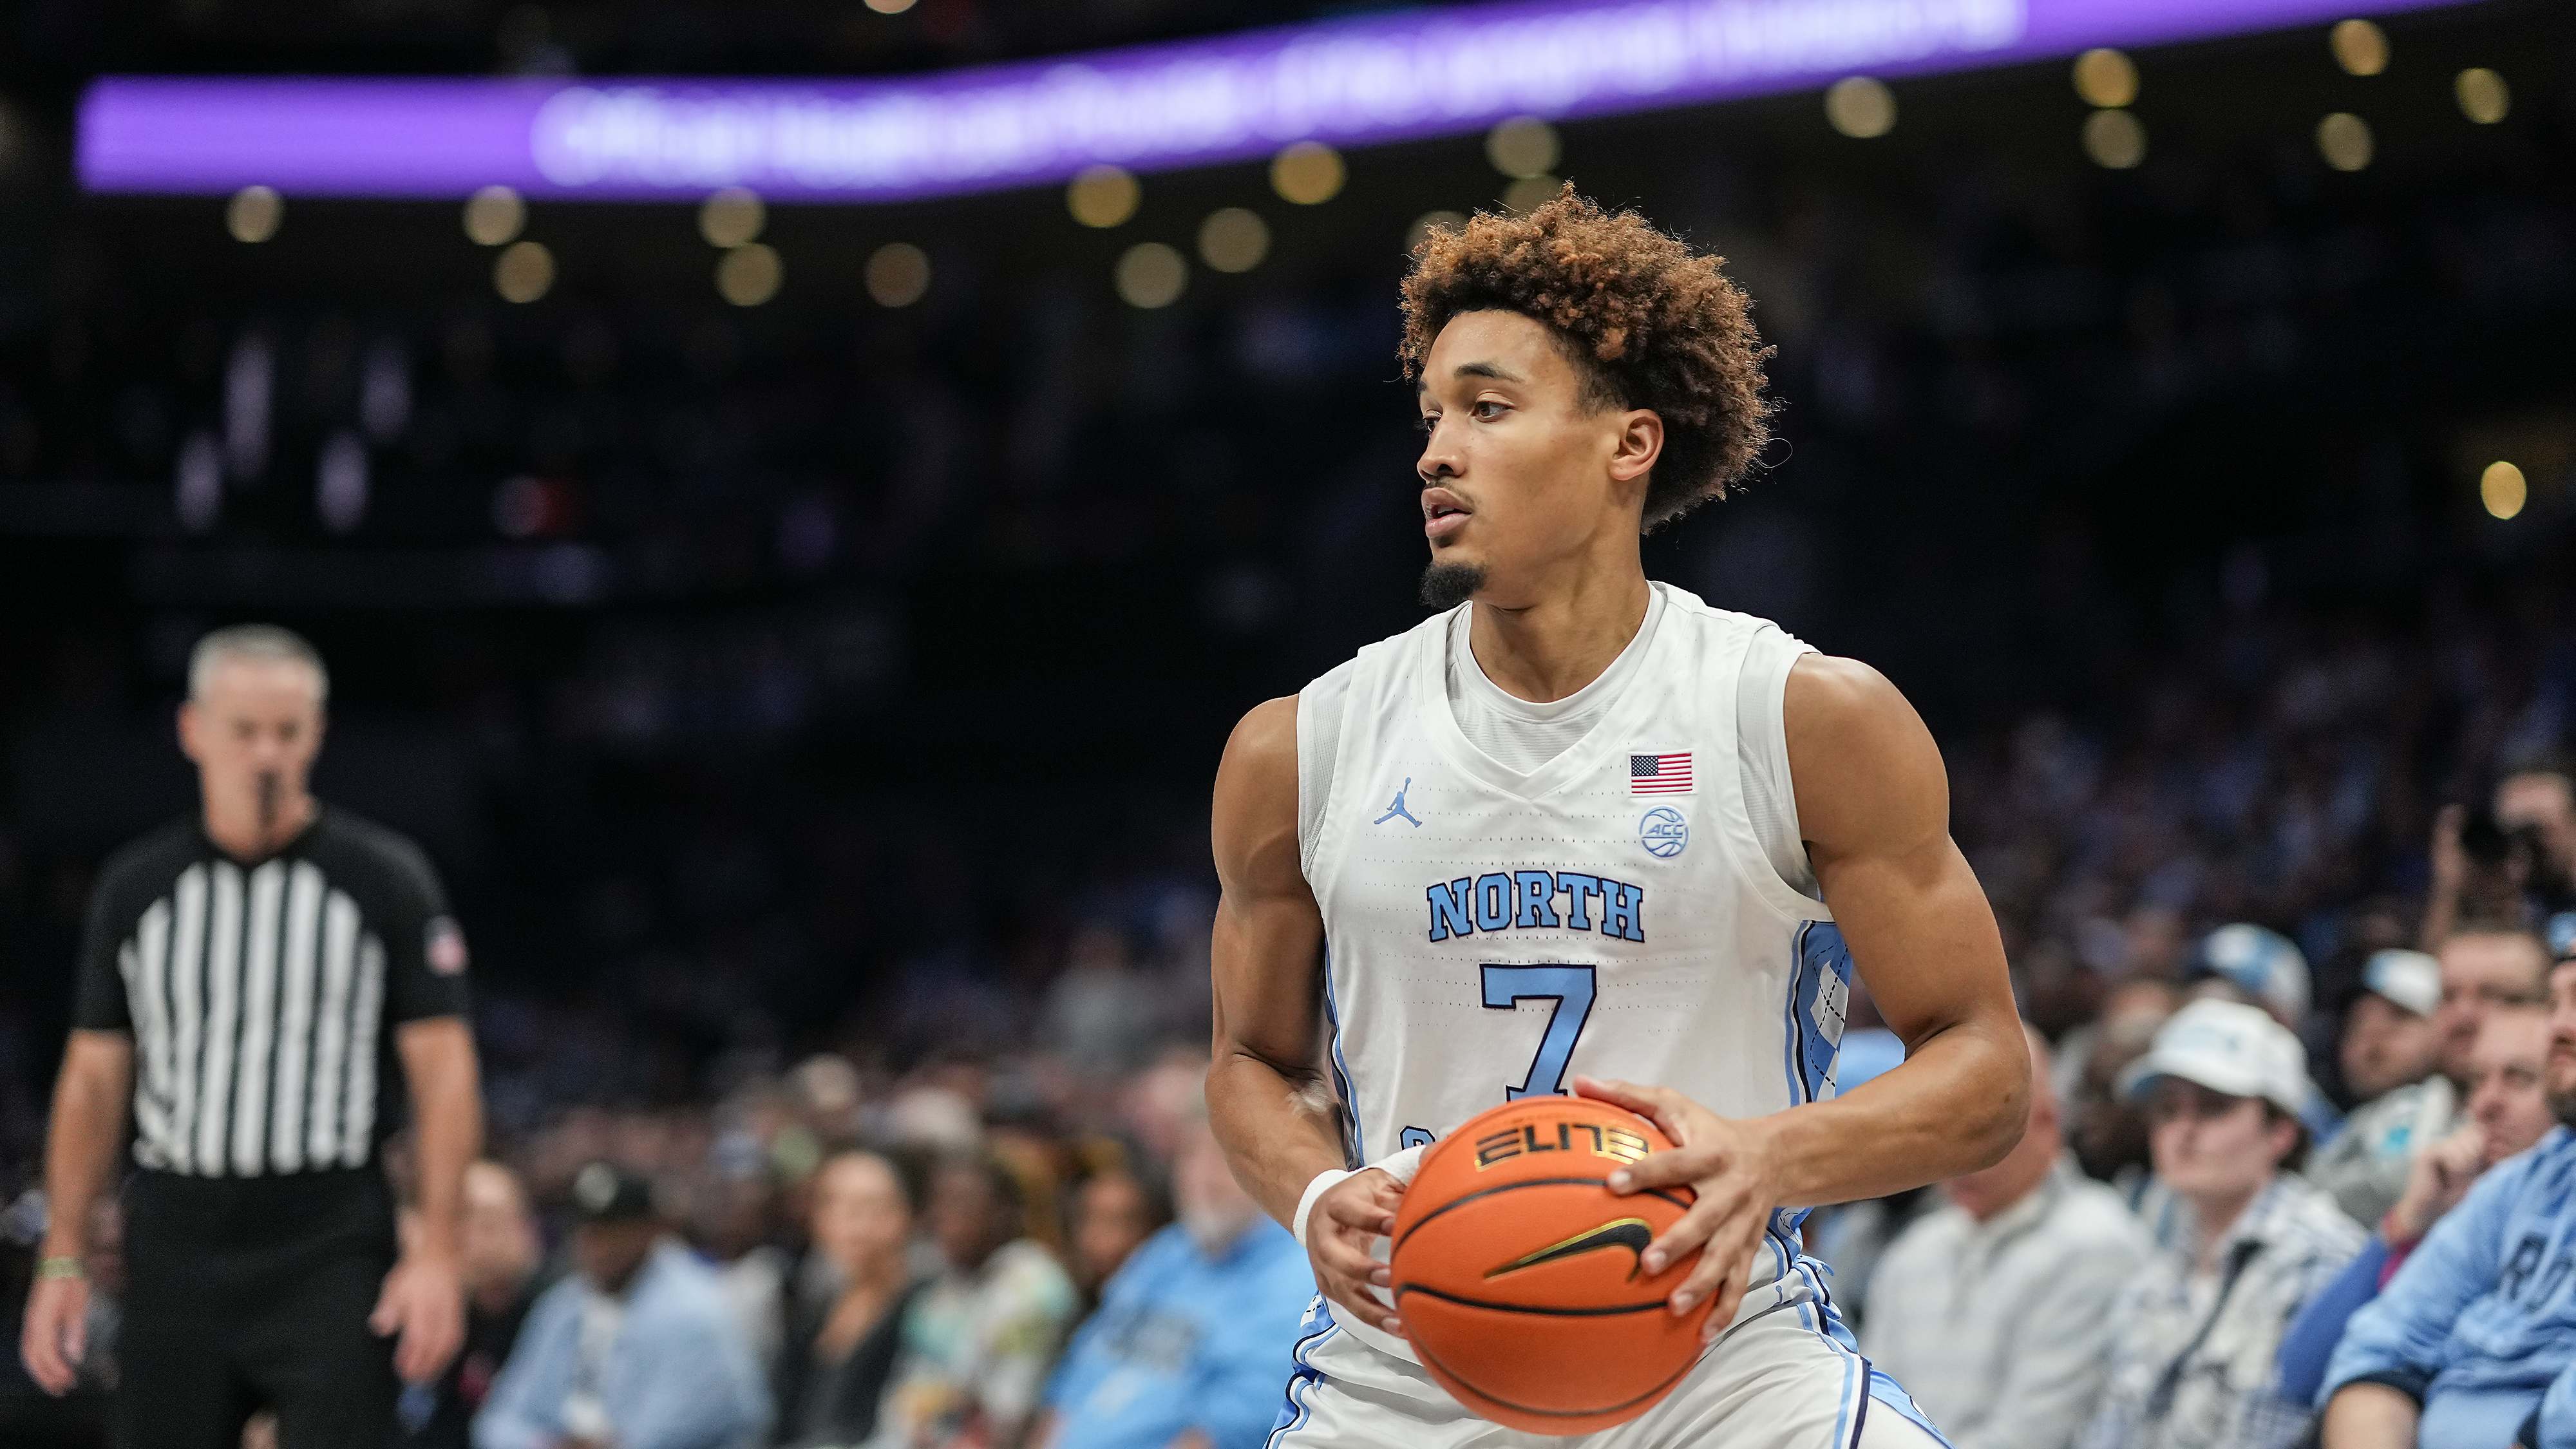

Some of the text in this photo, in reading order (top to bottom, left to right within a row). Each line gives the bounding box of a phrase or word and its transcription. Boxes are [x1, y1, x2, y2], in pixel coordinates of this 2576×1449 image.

[1645, 824, 1685, 836] ACC
[1426, 870, 1645, 943] NORTH
[1479, 963, 1597, 1103] 7
[1473, 1122, 1650, 1172] ELITE
